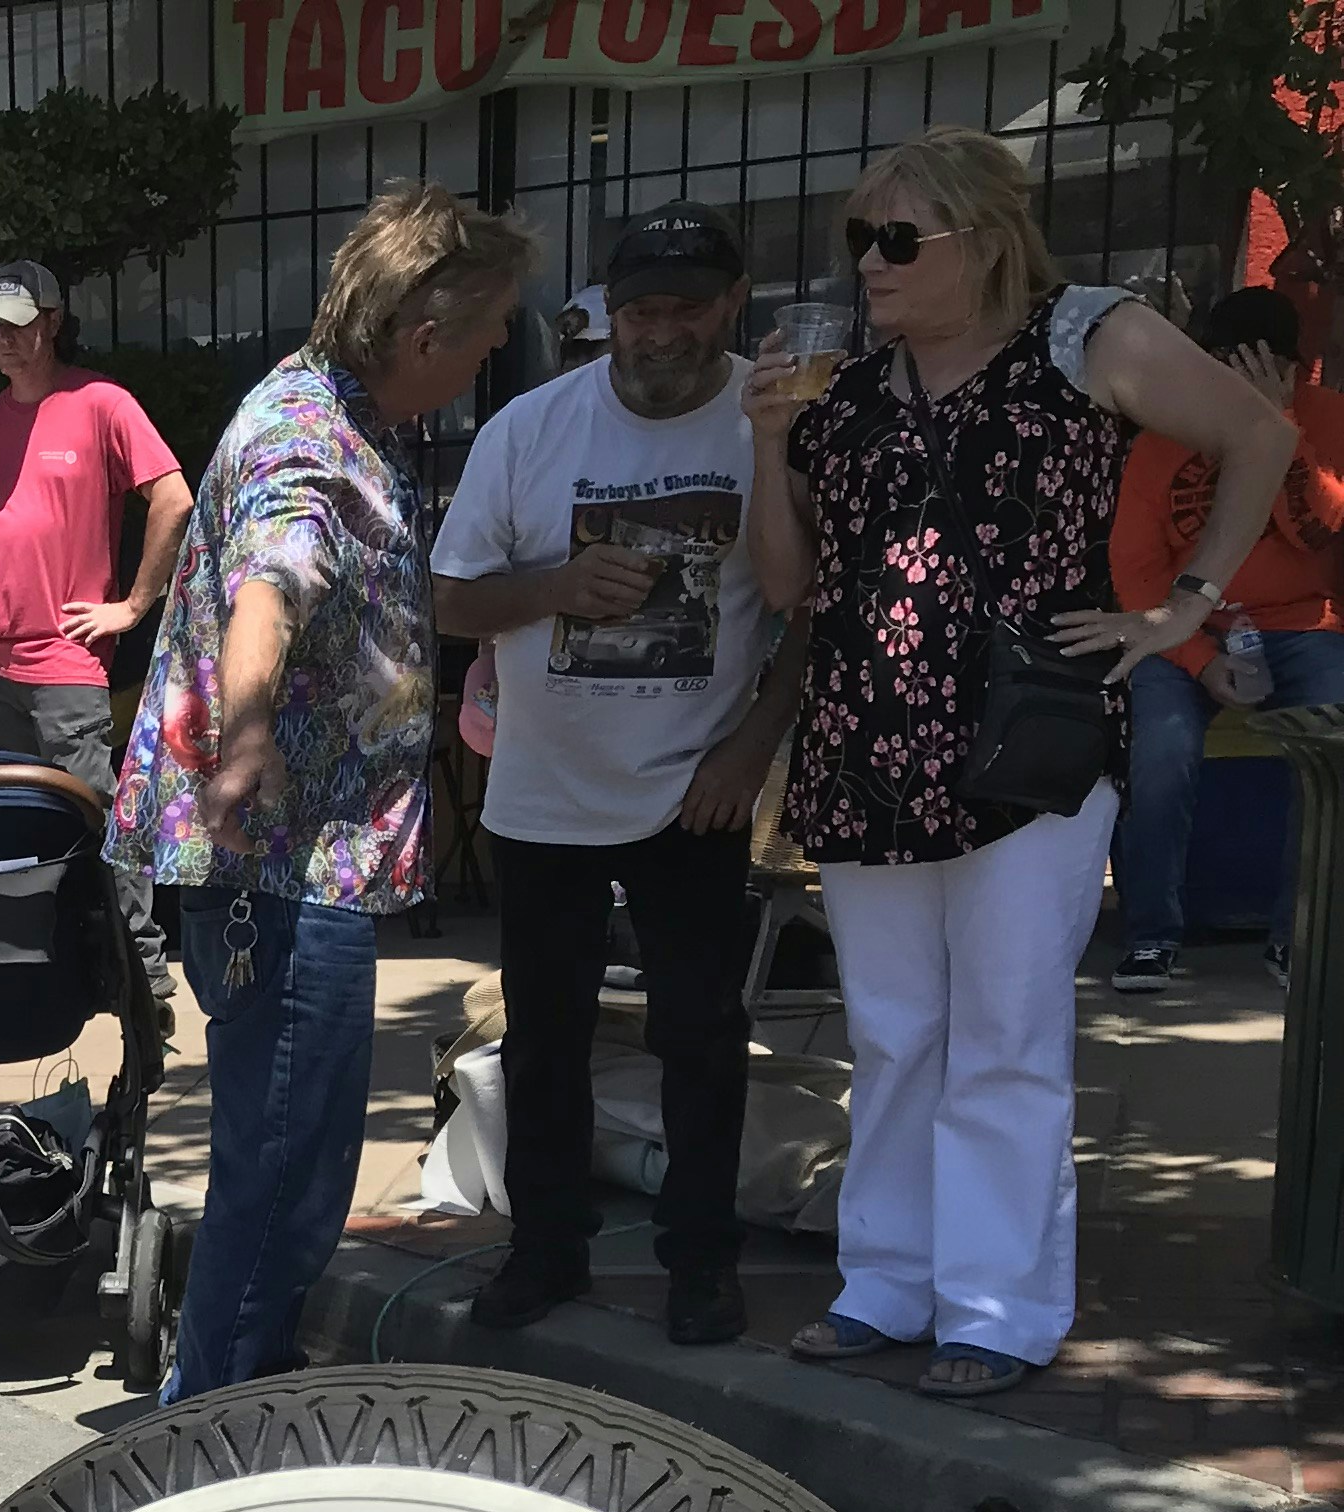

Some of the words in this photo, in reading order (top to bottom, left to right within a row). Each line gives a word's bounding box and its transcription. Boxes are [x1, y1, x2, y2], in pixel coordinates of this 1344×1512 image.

[232, 0, 502, 116] TACO
[574, 479, 642, 500] Cowboys
[663, 471, 739, 492] Chocolate
